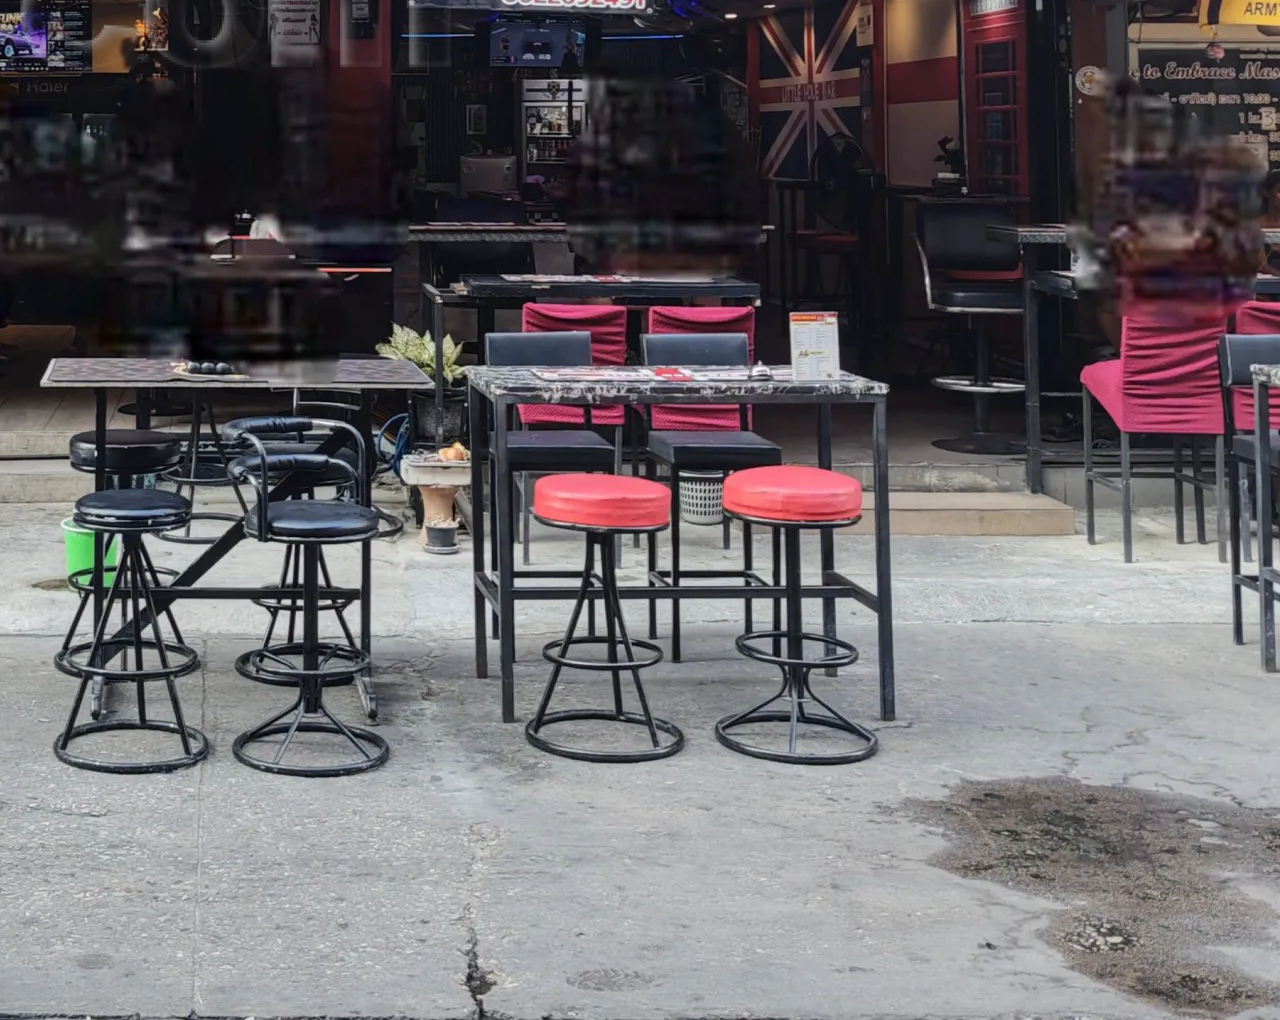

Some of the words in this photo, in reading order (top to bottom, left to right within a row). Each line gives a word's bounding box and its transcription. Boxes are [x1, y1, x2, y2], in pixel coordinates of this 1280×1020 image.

[1143, 64, 1161, 79] to
[1164, 61, 1236, 79] Embrace
[27, 81, 69, 93] Haier
